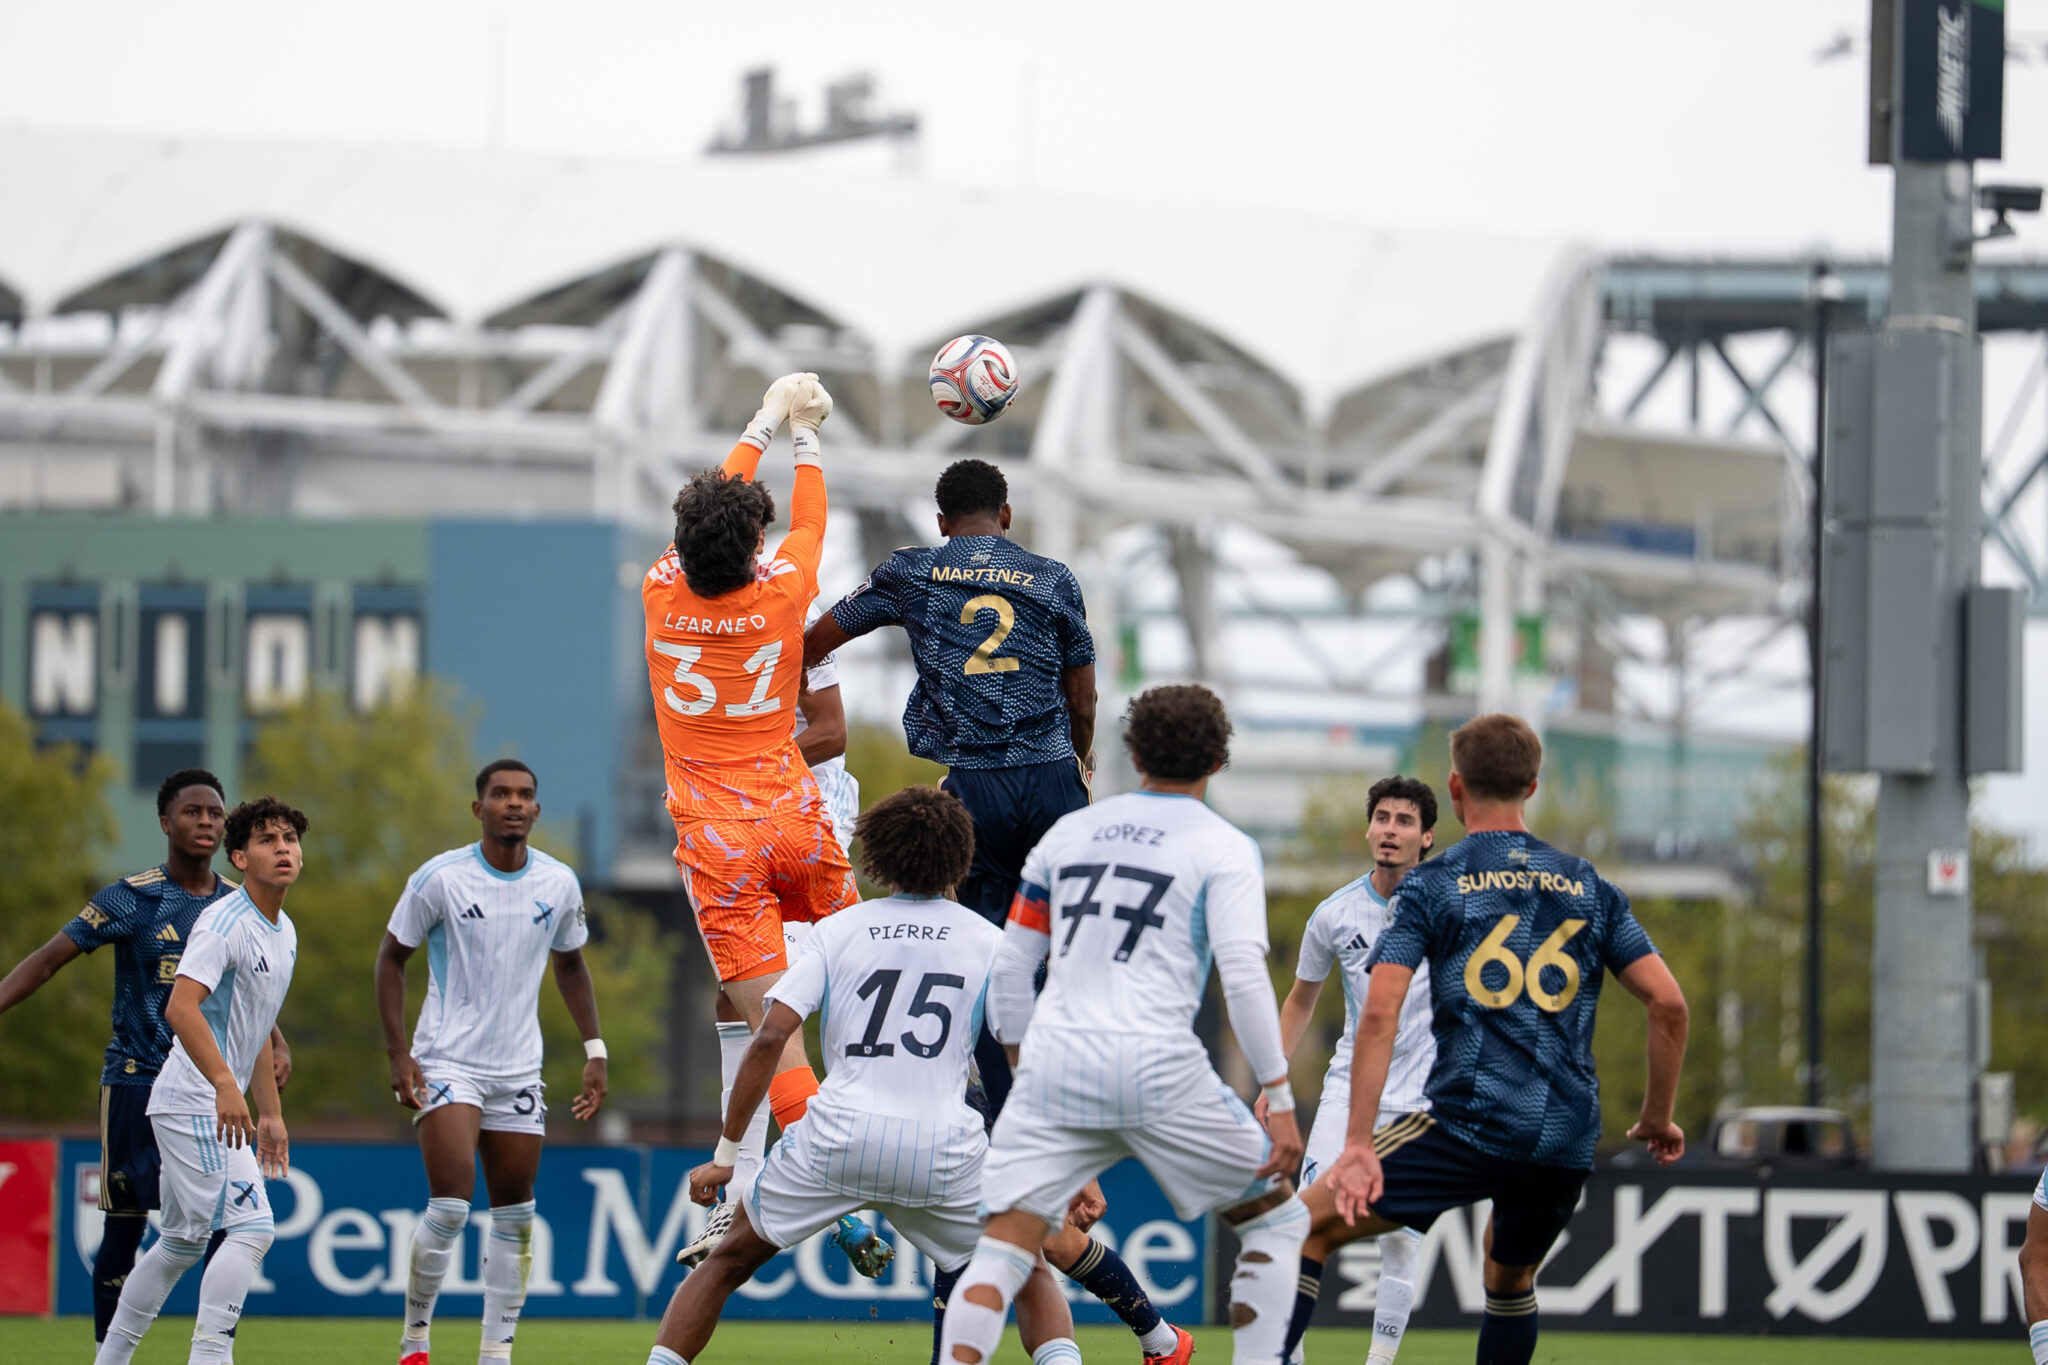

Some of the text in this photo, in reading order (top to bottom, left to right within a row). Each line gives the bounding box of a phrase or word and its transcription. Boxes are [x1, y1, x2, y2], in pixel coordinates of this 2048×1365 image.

[931, 566, 1035, 588] MARTINEZ
[664, 611, 767, 635] LEARNED
[960, 594, 1020, 676] 2
[30, 611, 425, 716] NION
[653, 639, 783, 717] 31
[1092, 823, 1167, 847] LOPEZ
[1456, 870, 1585, 897] SUNDSTROM
[868, 922, 952, 942] PIERRE
[1058, 863, 1176, 963] 77
[1464, 913, 1588, 1013] 66
[845, 968, 966, 1059] 15
[1375, 1320, 1399, 1335] NYC
